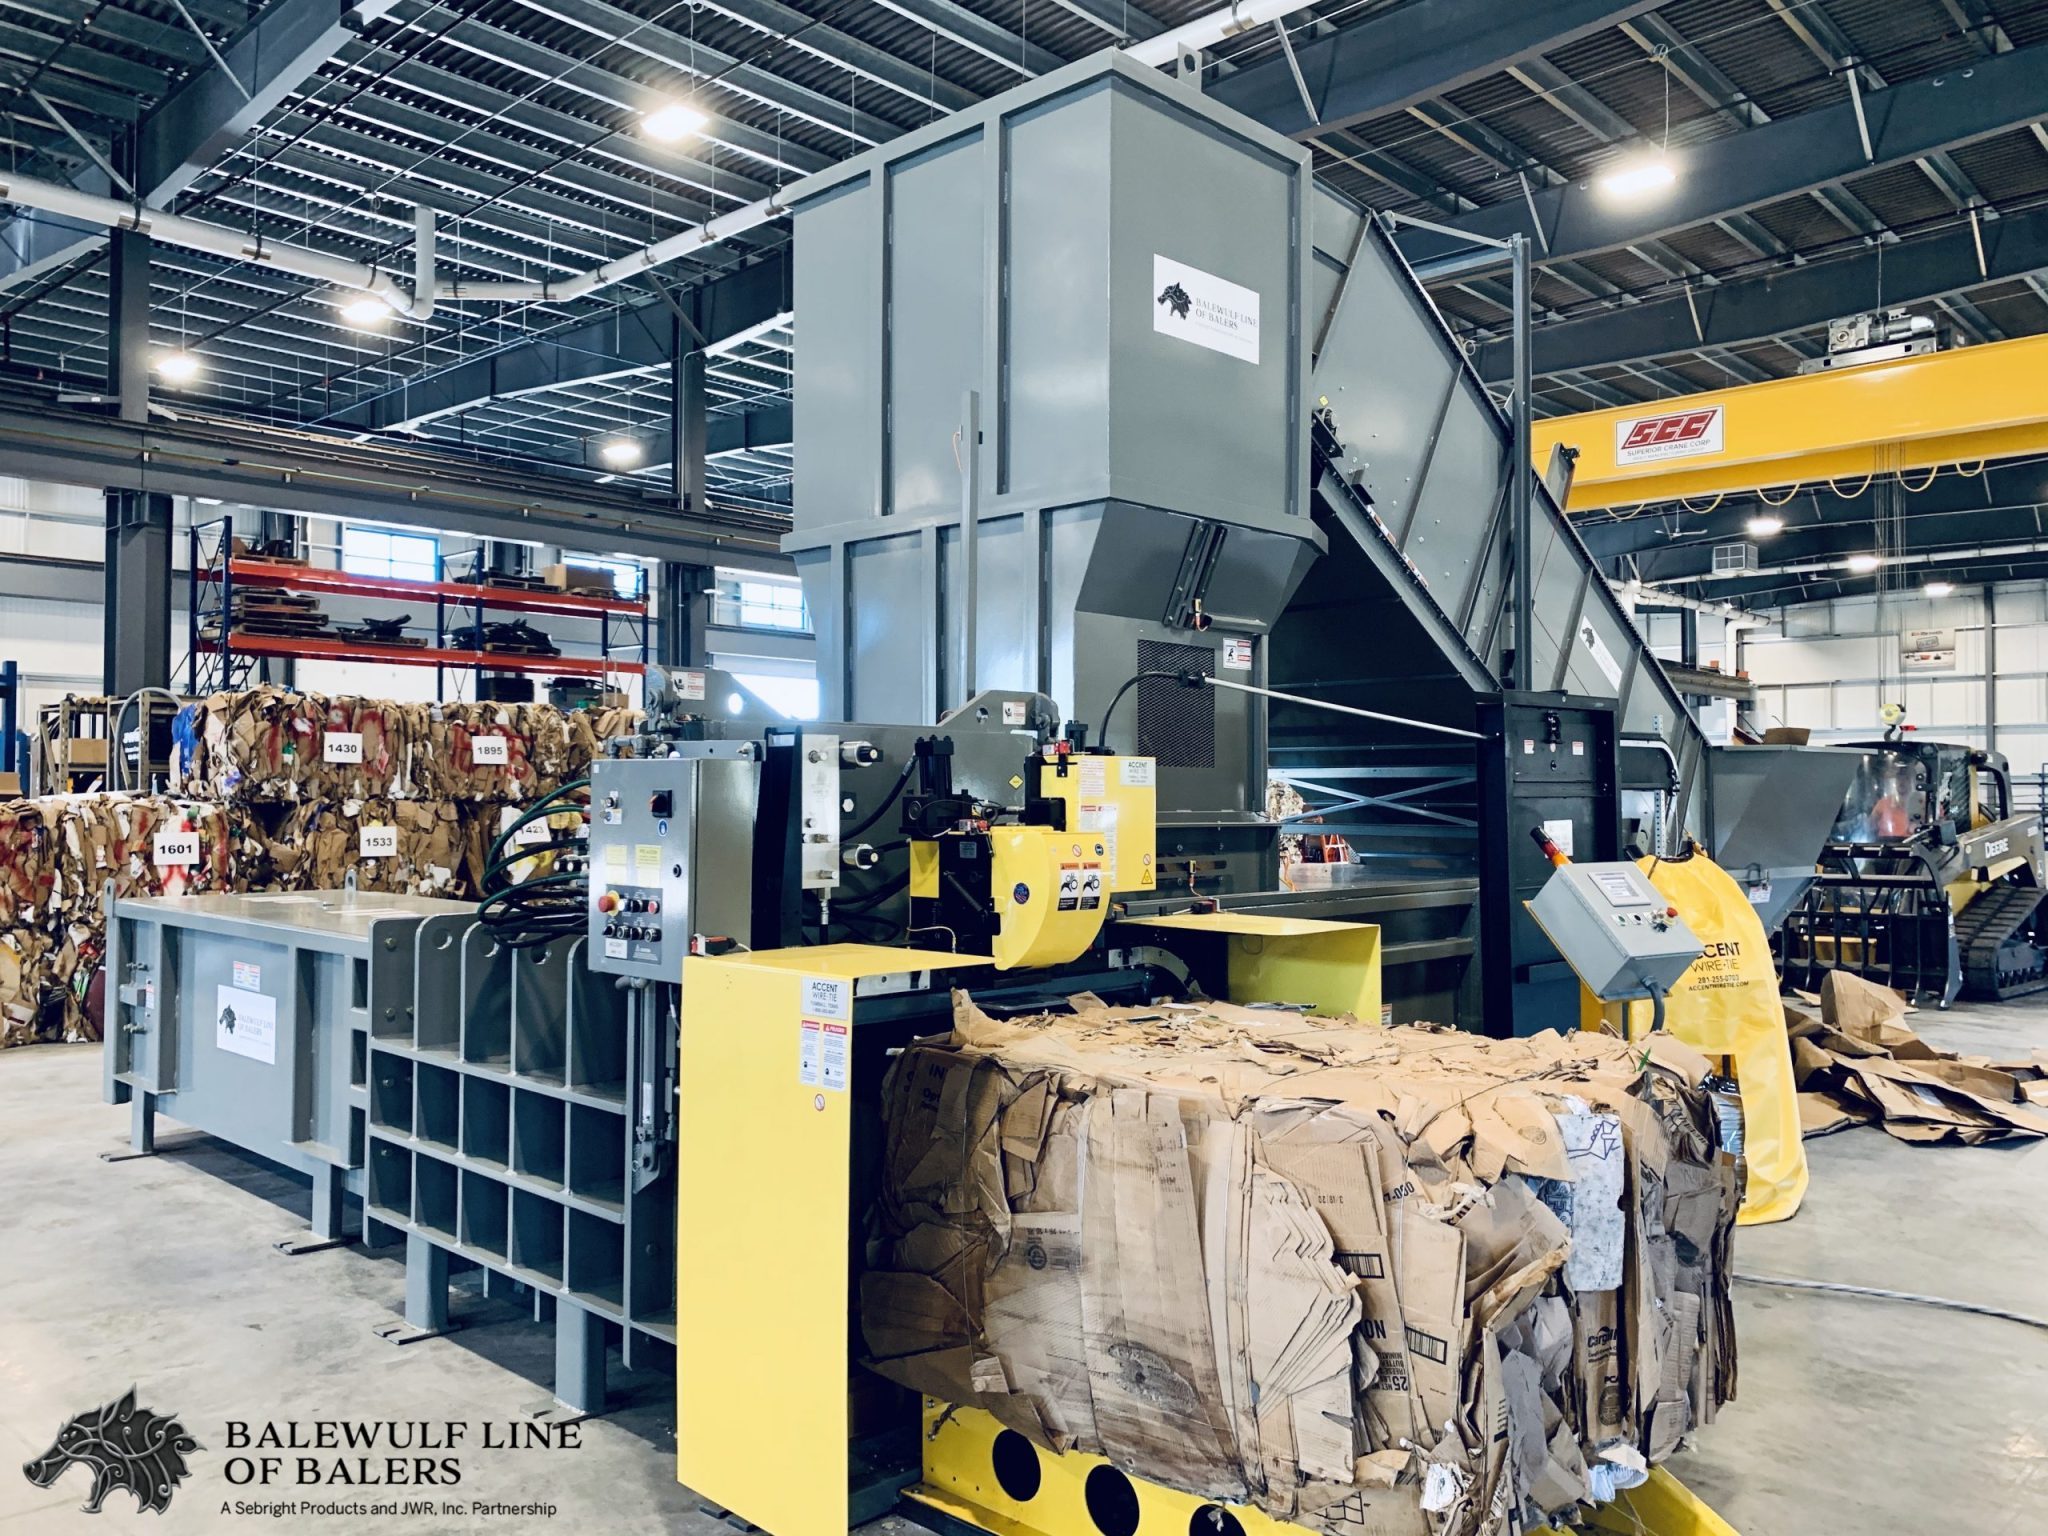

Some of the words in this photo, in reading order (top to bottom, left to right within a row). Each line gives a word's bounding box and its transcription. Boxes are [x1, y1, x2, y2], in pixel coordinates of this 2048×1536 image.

[1195, 308, 1206, 319] OF
[1208, 311, 1238, 329] BALERS
[1196, 298, 1238, 319] BALEWULF
[1240, 313, 1257, 328] LINE
[1625, 412, 1713, 447] SCC
[1627, 446, 1661, 457] SUPERIOR
[1663, 442, 1688, 452] CRANE
[1689, 439, 1711, 448] CORP
[328, 743, 357, 754] 1430
[477, 746, 503, 756] 1895
[159, 844, 193, 855] 1601
[365, 836, 393, 847] 1533
[1985, 838, 2009, 858] DEERE
[1697, 942, 1740, 960] CENT
[812, 982, 838, 993] ACCENT
[1392, 1376, 1408, 1391] 25
